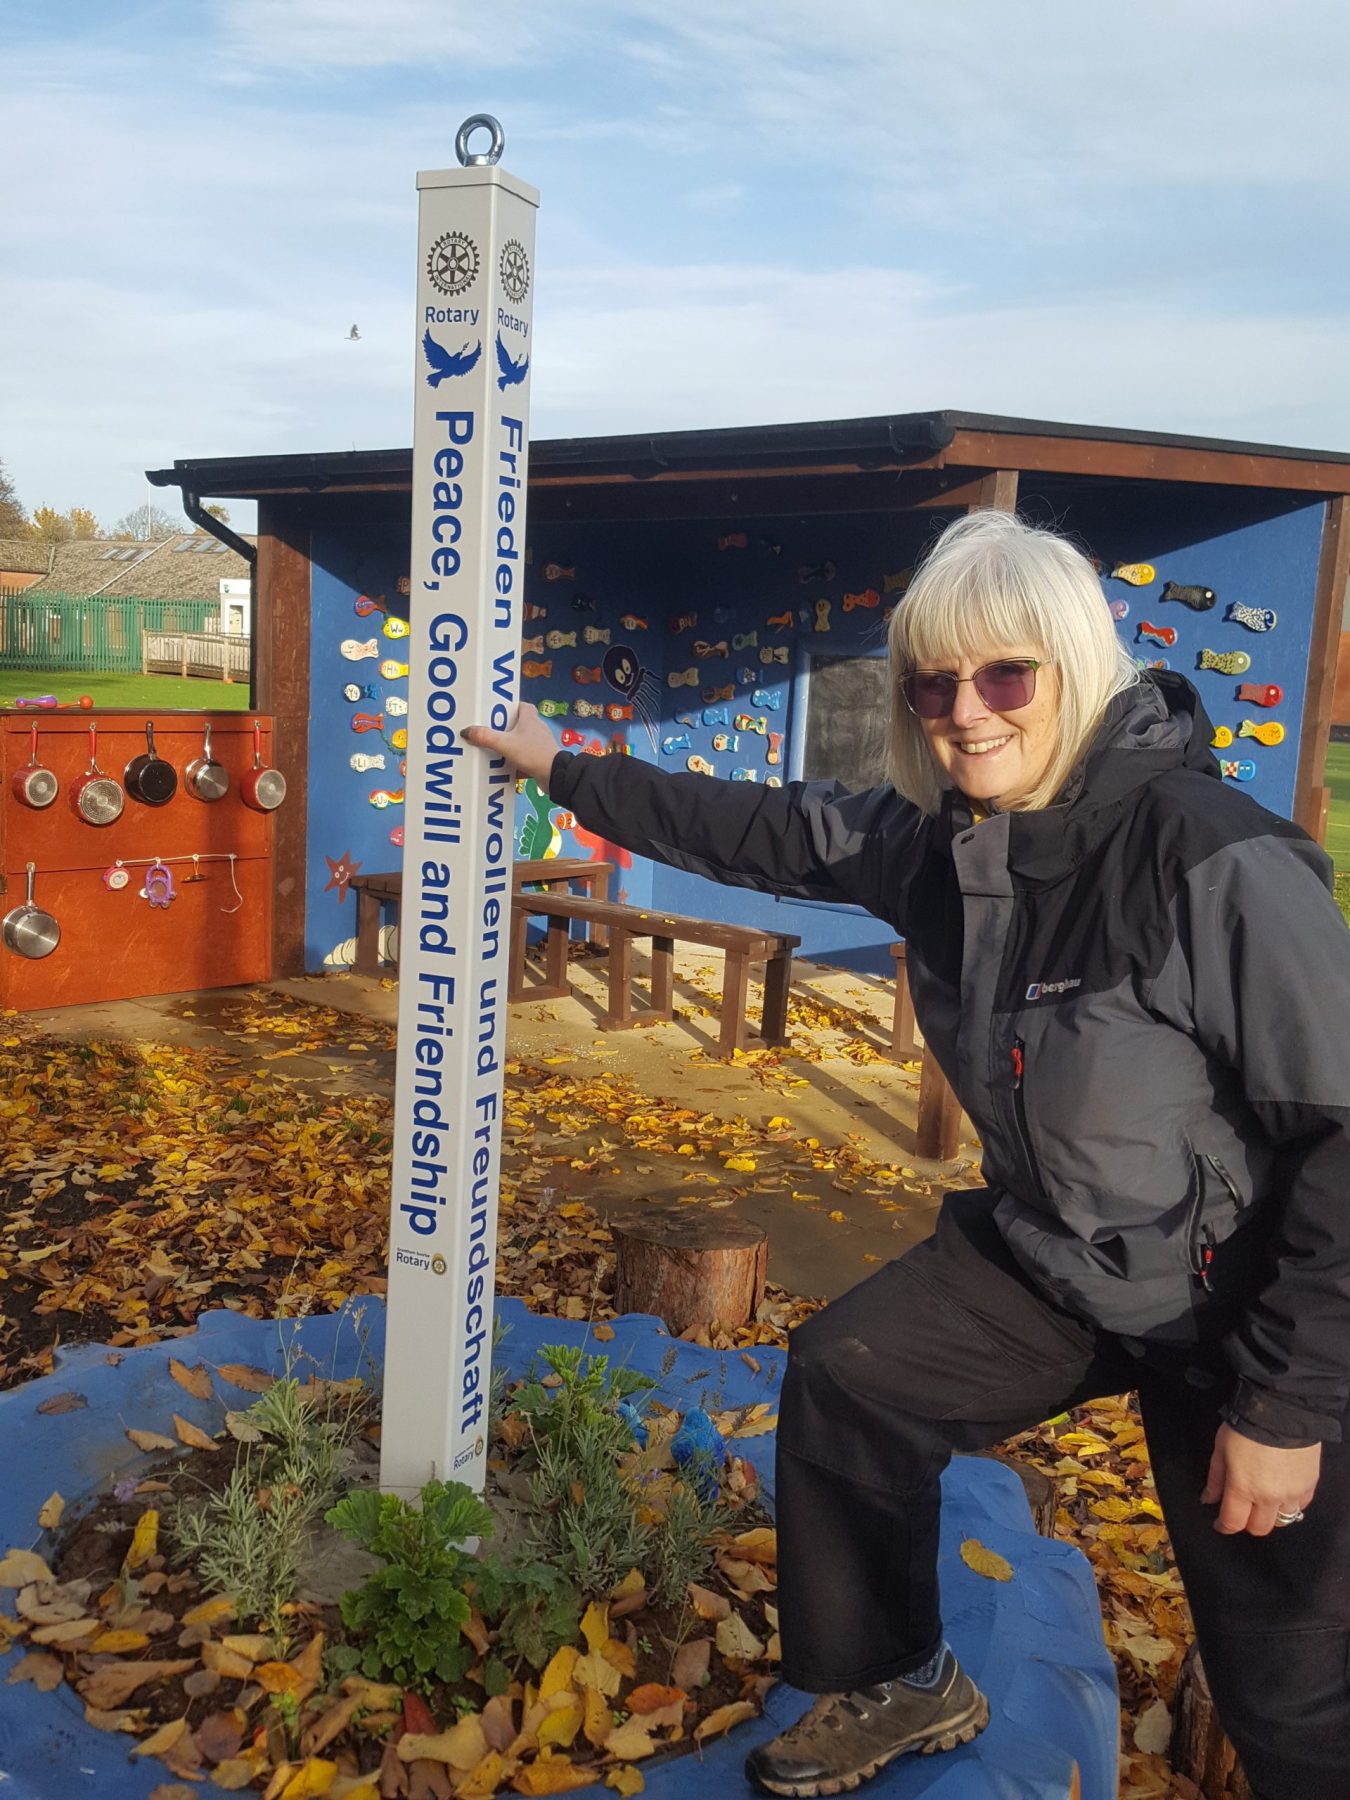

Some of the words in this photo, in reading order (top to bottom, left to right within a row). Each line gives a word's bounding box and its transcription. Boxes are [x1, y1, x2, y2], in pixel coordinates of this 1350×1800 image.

[433, 273, 472, 290] INTERNATIONAL
[443, 238, 466, 247] ROTARY
[425, 306, 480, 326] Rotary
[497, 307, 529, 338] Rotary
[423, 411, 475, 591] Peace,
[494, 415, 523, 629] Frieden
[423, 613, 469, 844] Goodwill
[481, 649, 516, 961] Wolwollen
[419, 860, 457, 956] and
[477, 978, 499, 1077] und
[1041, 978, 1081, 994] berghau
[399, 972, 456, 1236] Friendship
[396, 1252, 430, 1271] Rotary
[461, 1092, 497, 1434] Freundschaft
[453, 1449, 475, 1471] Rotary
